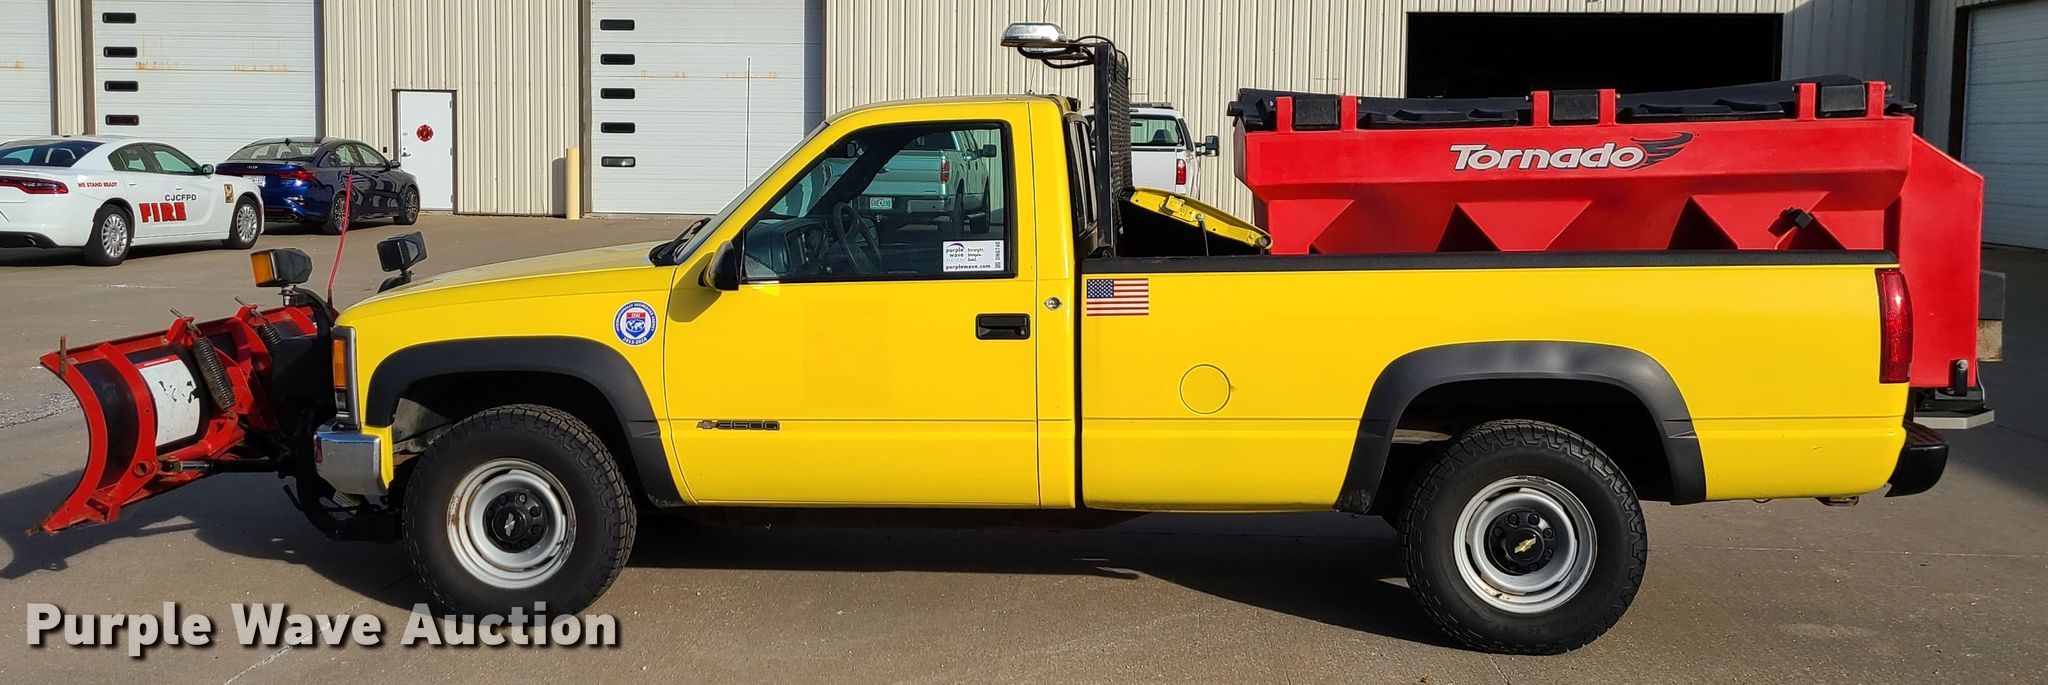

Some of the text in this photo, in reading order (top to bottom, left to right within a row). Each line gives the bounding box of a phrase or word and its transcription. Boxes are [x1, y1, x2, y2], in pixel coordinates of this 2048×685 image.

[1449, 142, 1646, 171] Tornado
[164, 194, 197, 202] CJCFPD
[139, 201, 187, 223] FIRE
